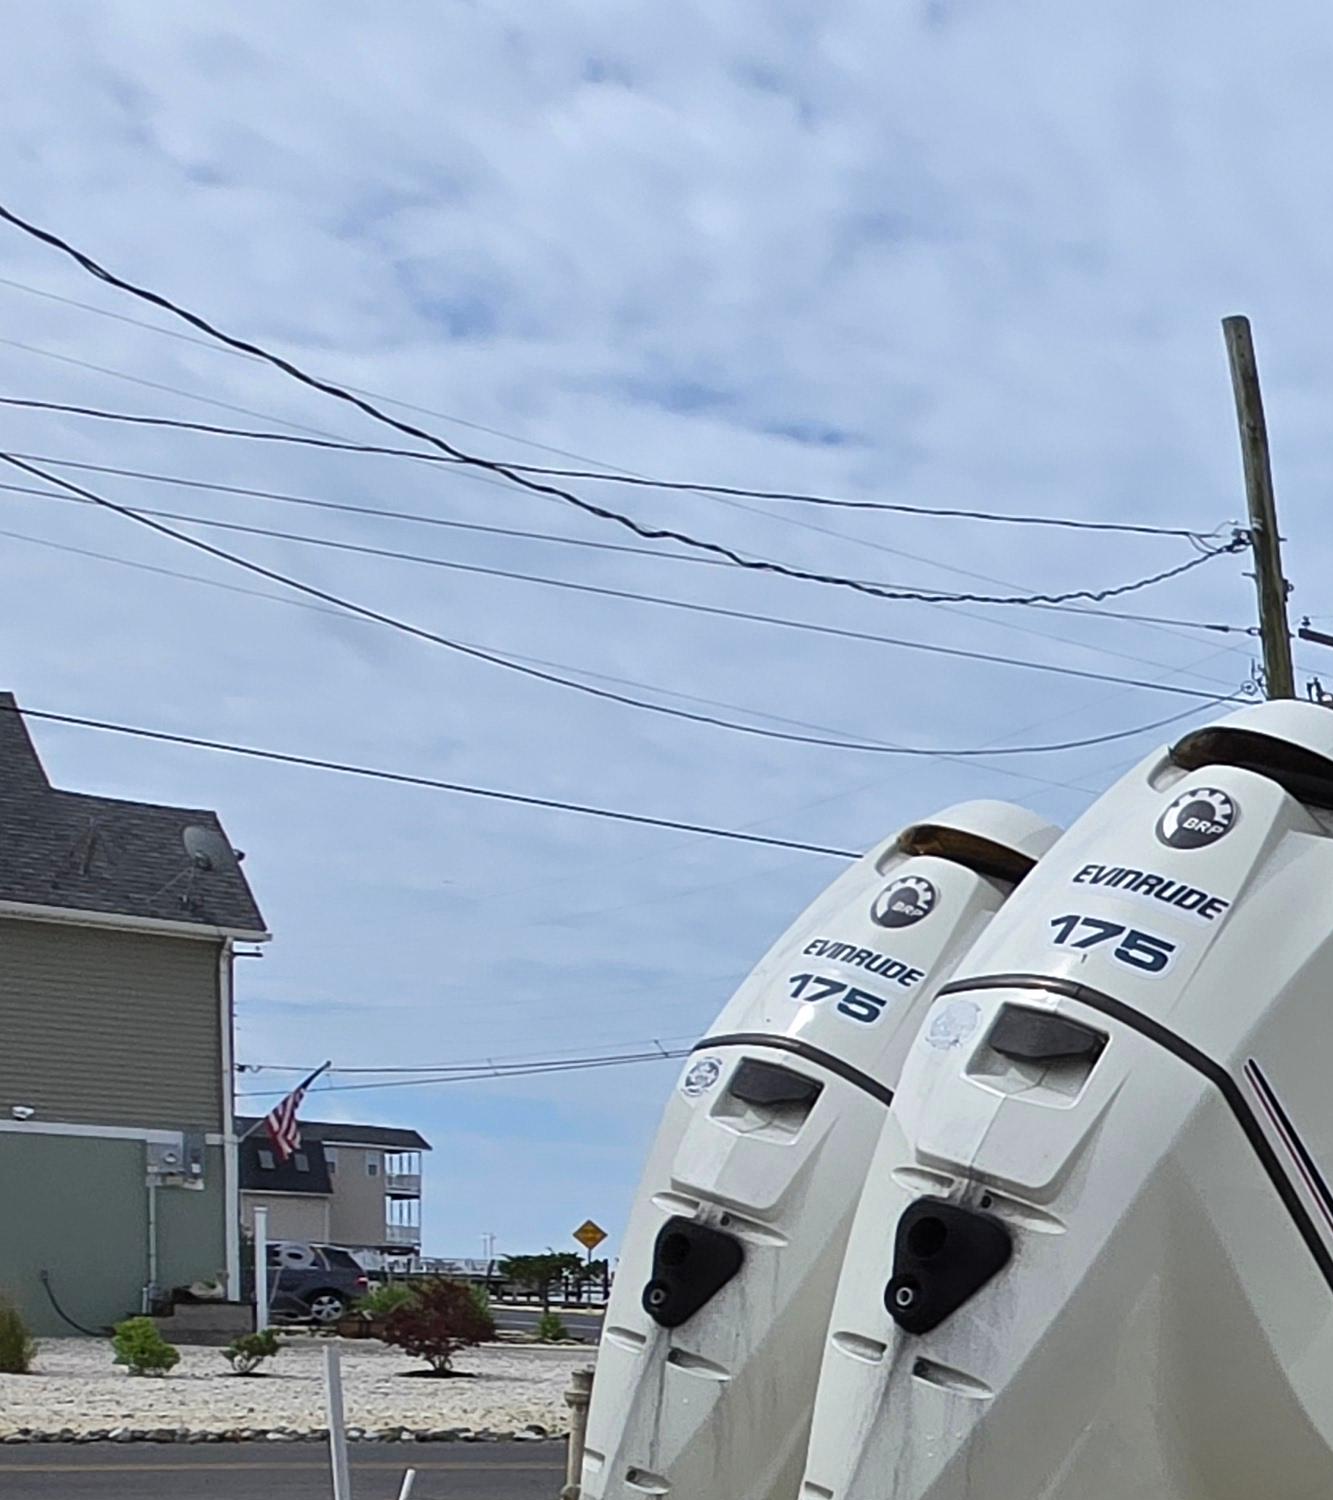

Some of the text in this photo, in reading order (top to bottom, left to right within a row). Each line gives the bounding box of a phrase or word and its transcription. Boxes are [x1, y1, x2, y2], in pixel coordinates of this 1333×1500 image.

[1182, 817, 1224, 834] BRP
[1072, 864, 1229, 921] EVINRUDE
[803, 939, 925, 987] EVINRUDE
[1050, 914, 1176, 973] 175
[789, 973, 887, 1023] 175
